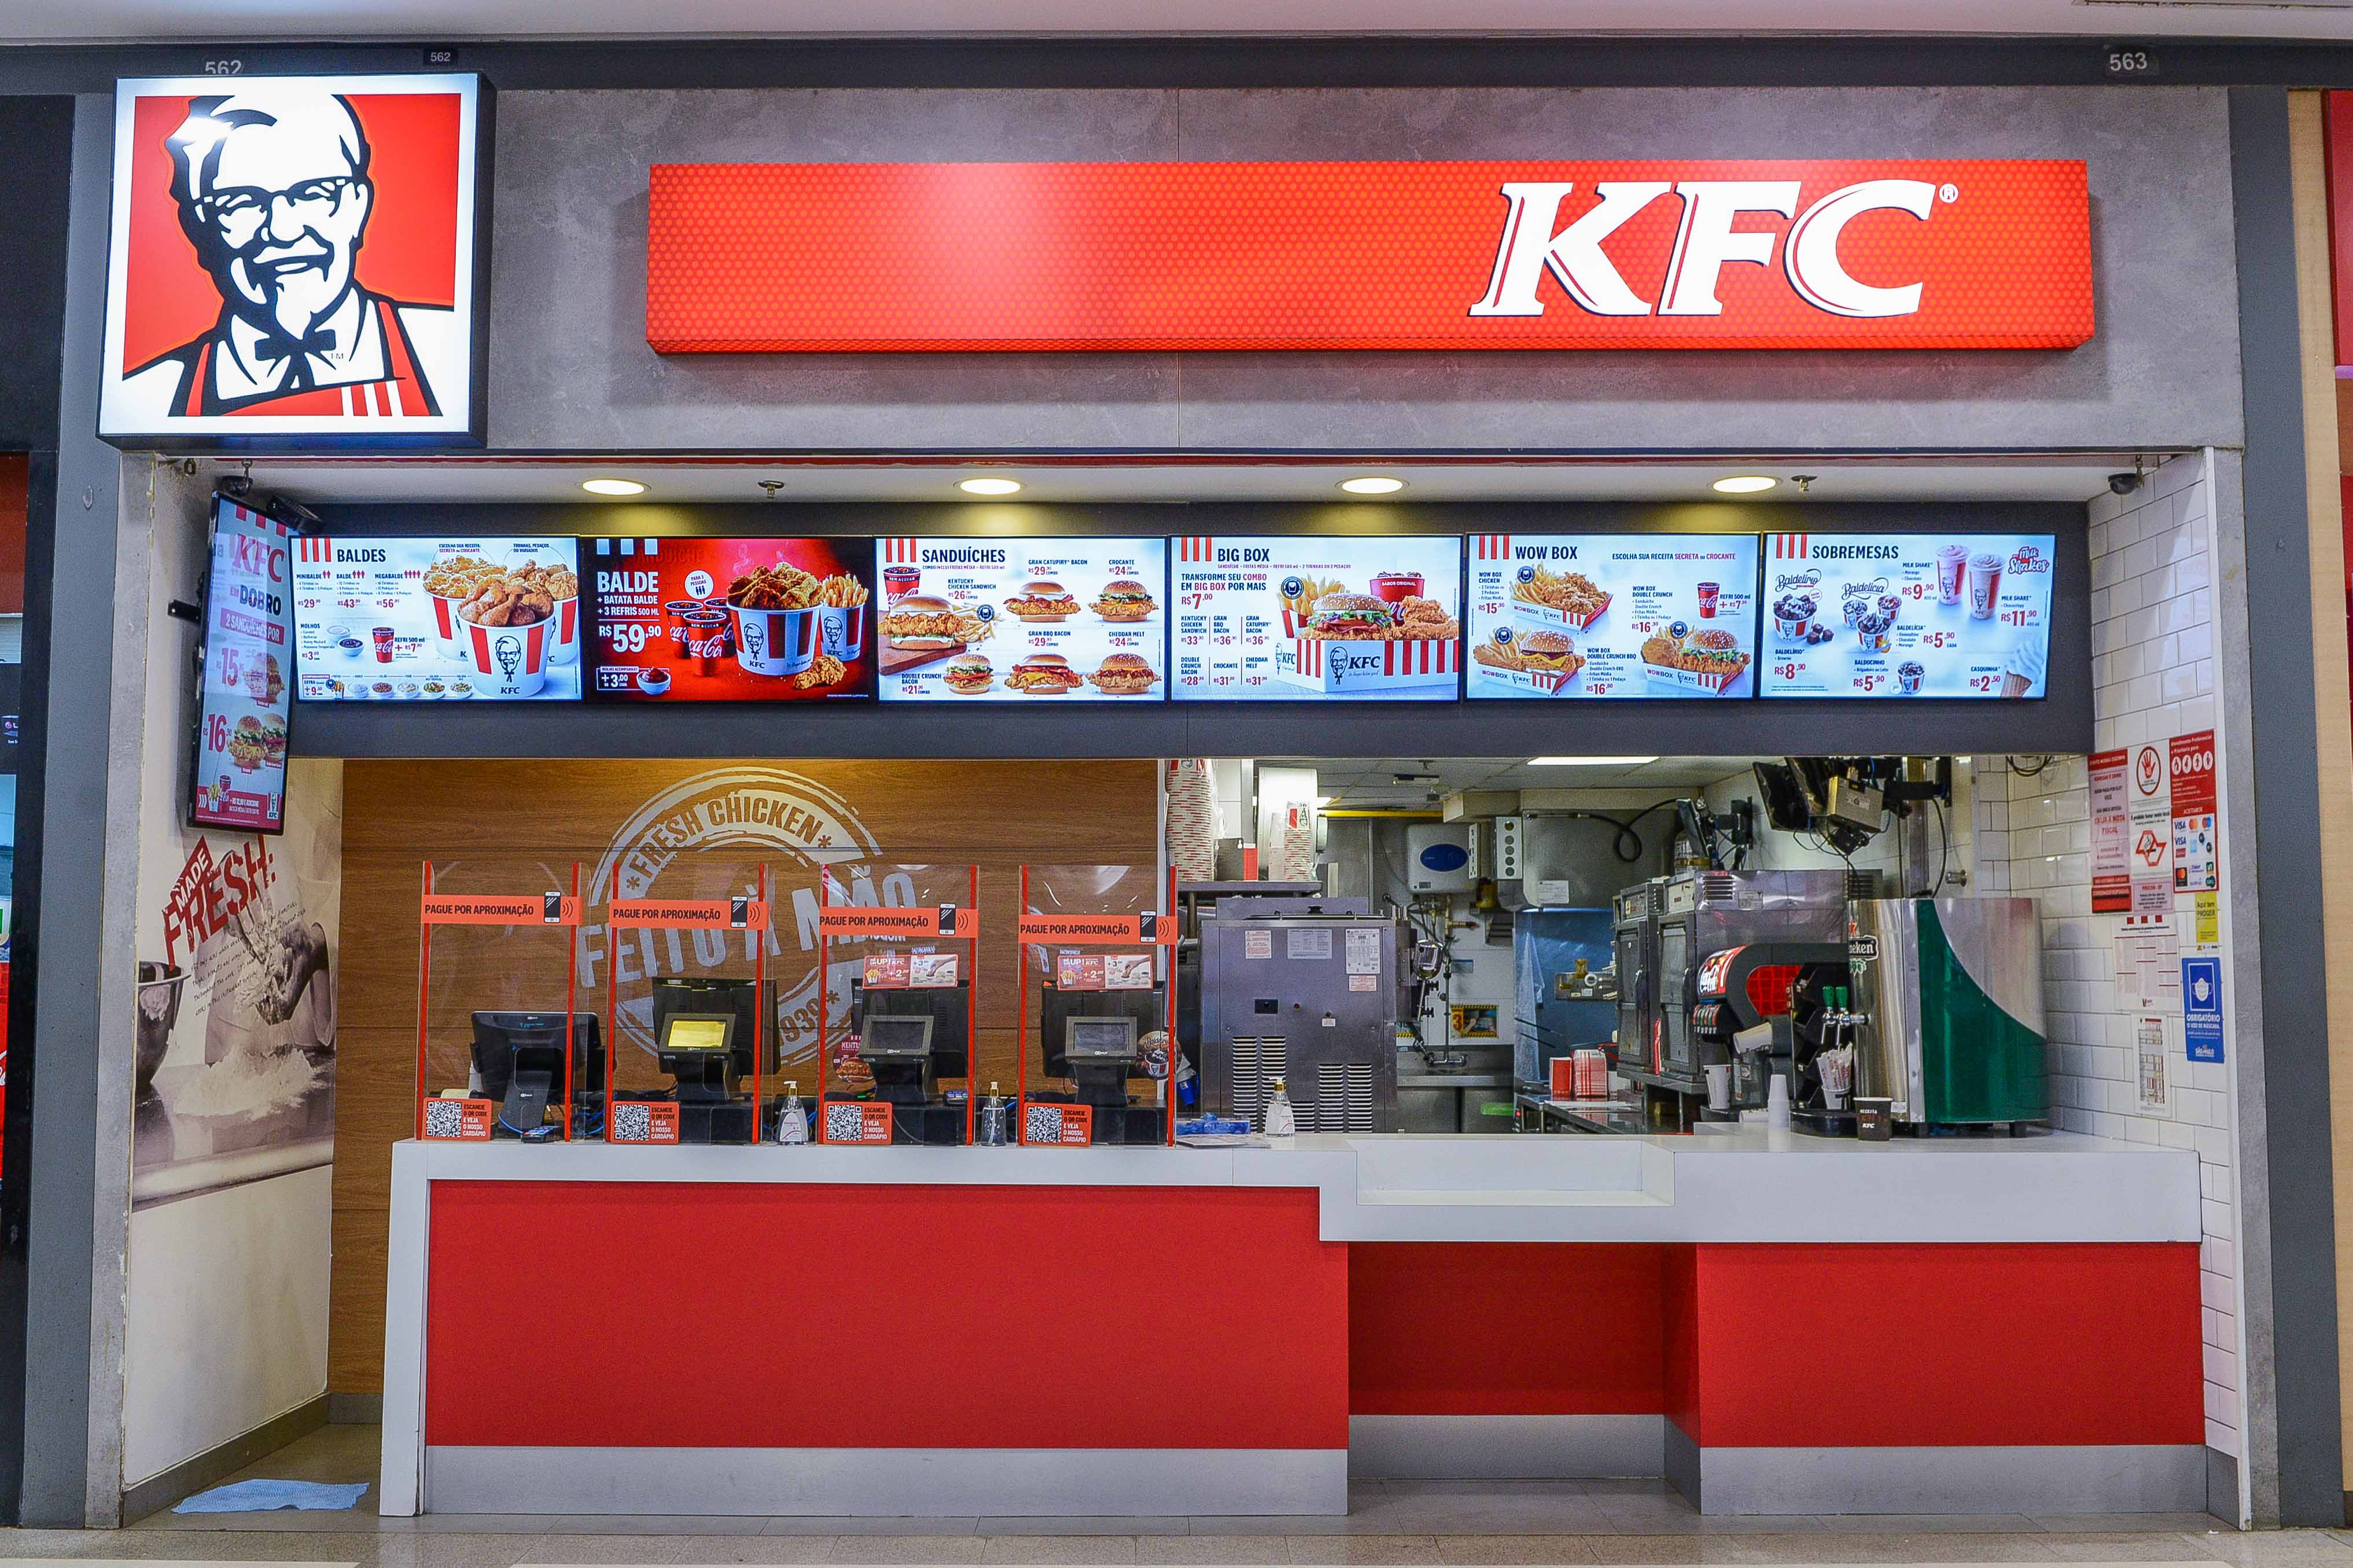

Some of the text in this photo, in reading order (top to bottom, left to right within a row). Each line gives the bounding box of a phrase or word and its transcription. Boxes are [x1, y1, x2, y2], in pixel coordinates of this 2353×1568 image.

[430, 51, 450, 62] 562
[2109, 53, 2148, 71] 563
[1467, 178, 1936, 319] KFC
[233, 533, 285, 582] KFC
[337, 549, 386, 562] BALDES
[922, 546, 1006, 562] SANDUÍCHES
[1218, 548, 1269, 562] BIG BOX
[1515, 546, 1577, 559] WOW BOX
[1812, 545, 1899, 559] SOBREMESAS
[597, 571, 659, 592] BALDE
[240, 585, 281, 615] DOBRO
[604, 596, 658, 604] BATATA BALDE
[604, 607, 609, 615] 3
[611, 607, 637, 615] REFRIS
[268, 626, 280, 641] POR
[1282, 652, 1296, 665] KFC
[1348, 656, 1380, 669] KFC
[1482, 670, 1508, 680] WOWBOX
[1647, 669, 1673, 678] WOWBOX
[2174, 821, 2186, 830] VISA
[628, 796, 824, 879] FRESH CHICKEN
[2175, 837, 2186, 846] VISA
[174, 848, 209, 909] MADE
[425, 904, 534, 917] PAGUE POR APROXIMAÇÃO
[613, 908, 721, 922] PAGUE POR APROXIMAÇÃO
[820, 916, 928, 929] PAGUE POR APROXIMAÇÃO
[1021, 923, 1130, 936] PAGUE POR APROXIMAÇÃO
[779, 998, 828, 1046] 939
[2186, 1013, 2220, 1022] OBRIGATÓRIO
